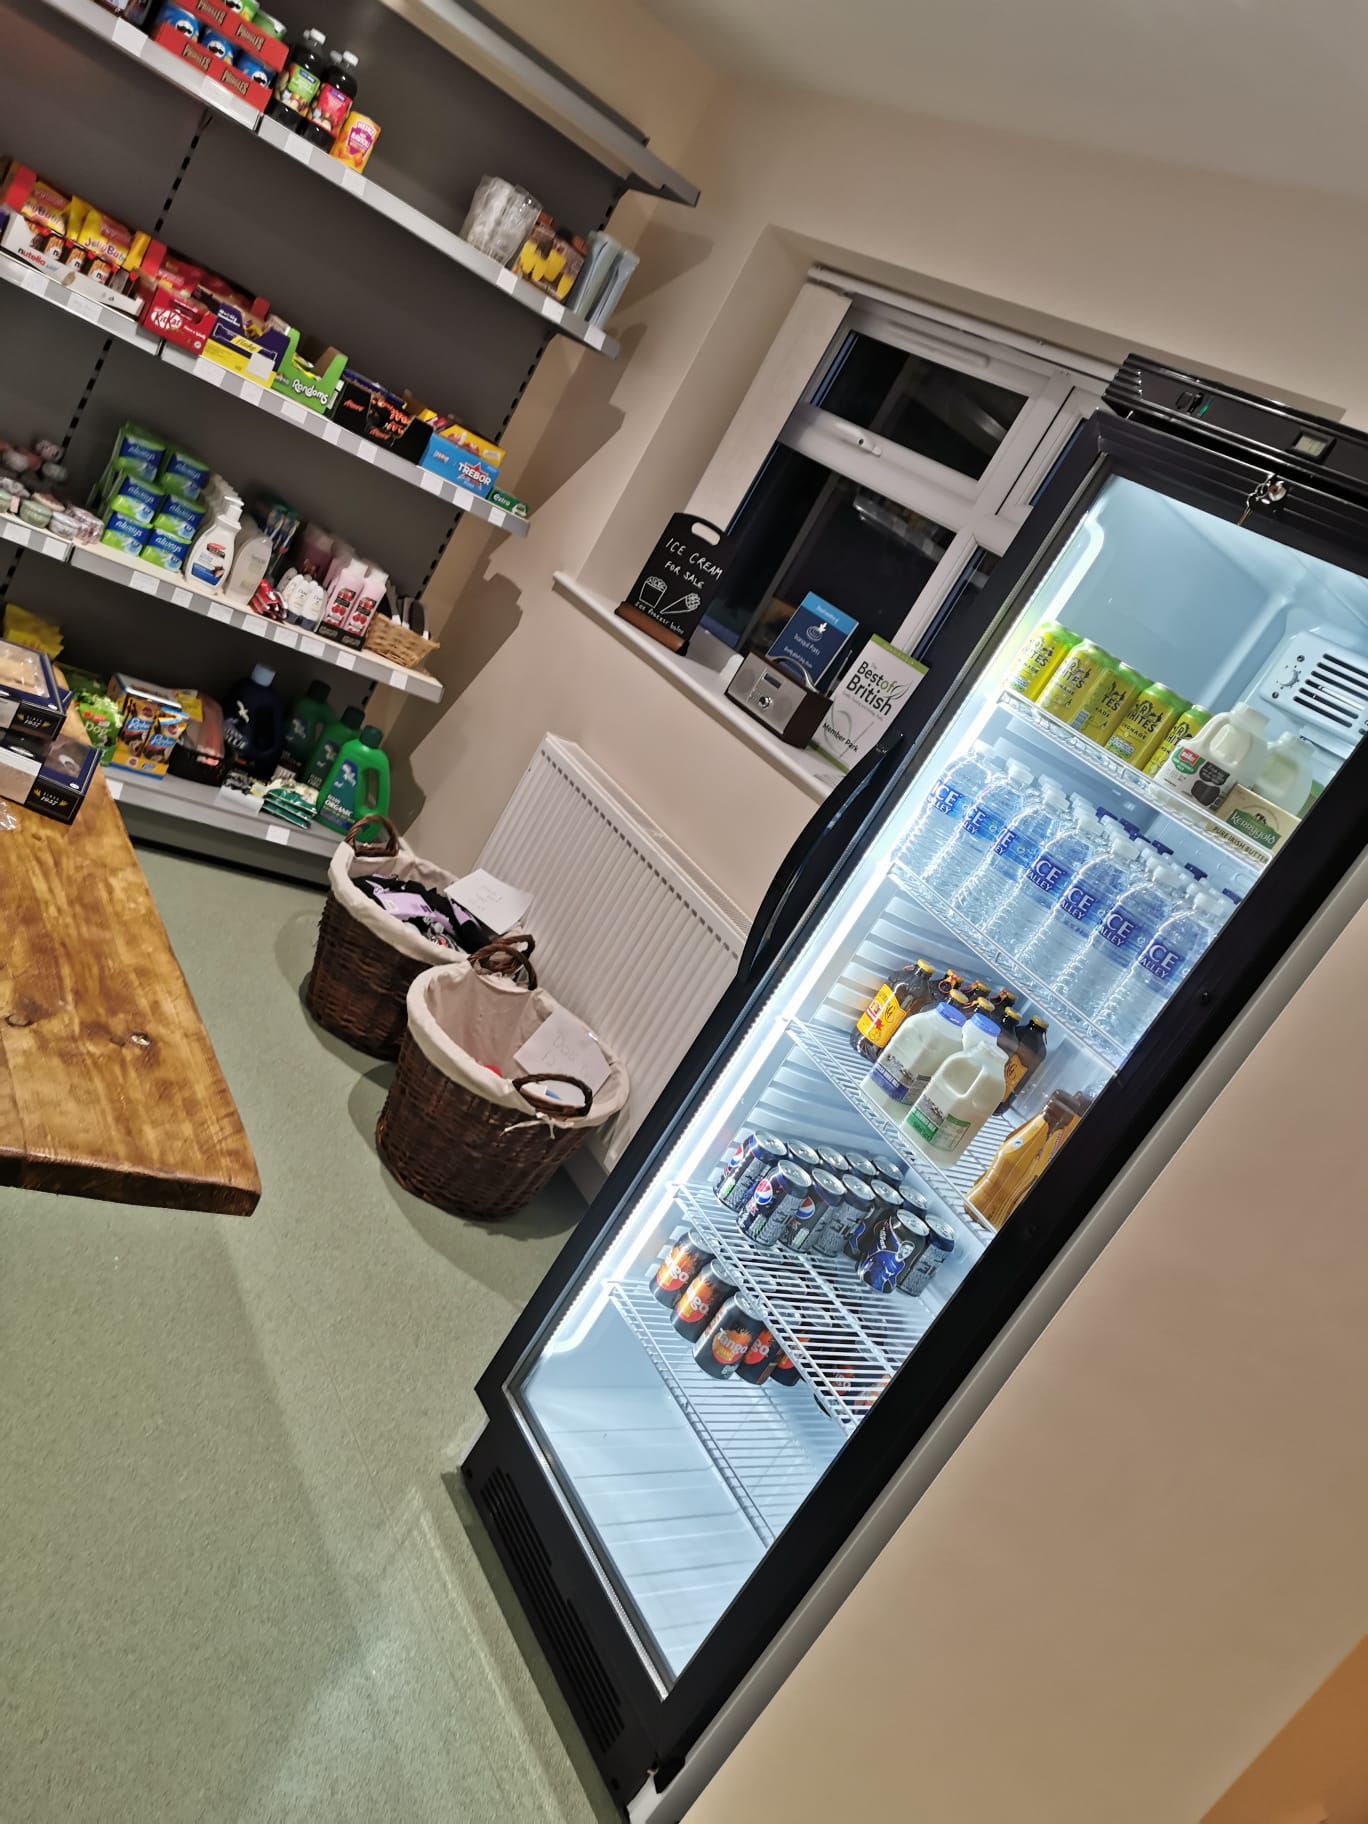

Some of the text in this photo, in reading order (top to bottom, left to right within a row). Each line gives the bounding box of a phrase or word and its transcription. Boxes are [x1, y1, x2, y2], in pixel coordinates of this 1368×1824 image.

[17, 247, 47, 267] nutella
[150, 309, 182, 329] KitKat
[292, 378, 329, 405] Randoms
[458, 462, 492, 486] TREBOR
[664, 560, 681, 576] FOR
[665, 537, 723, 581] ICE CREAM
[856, 660, 884, 687] Best
[846, 674, 893, 716] British
[822, 722, 859, 753] Member Park
[1230, 811, 1276, 845] Kerrygold
[717, 1327, 748, 1355] Tango
